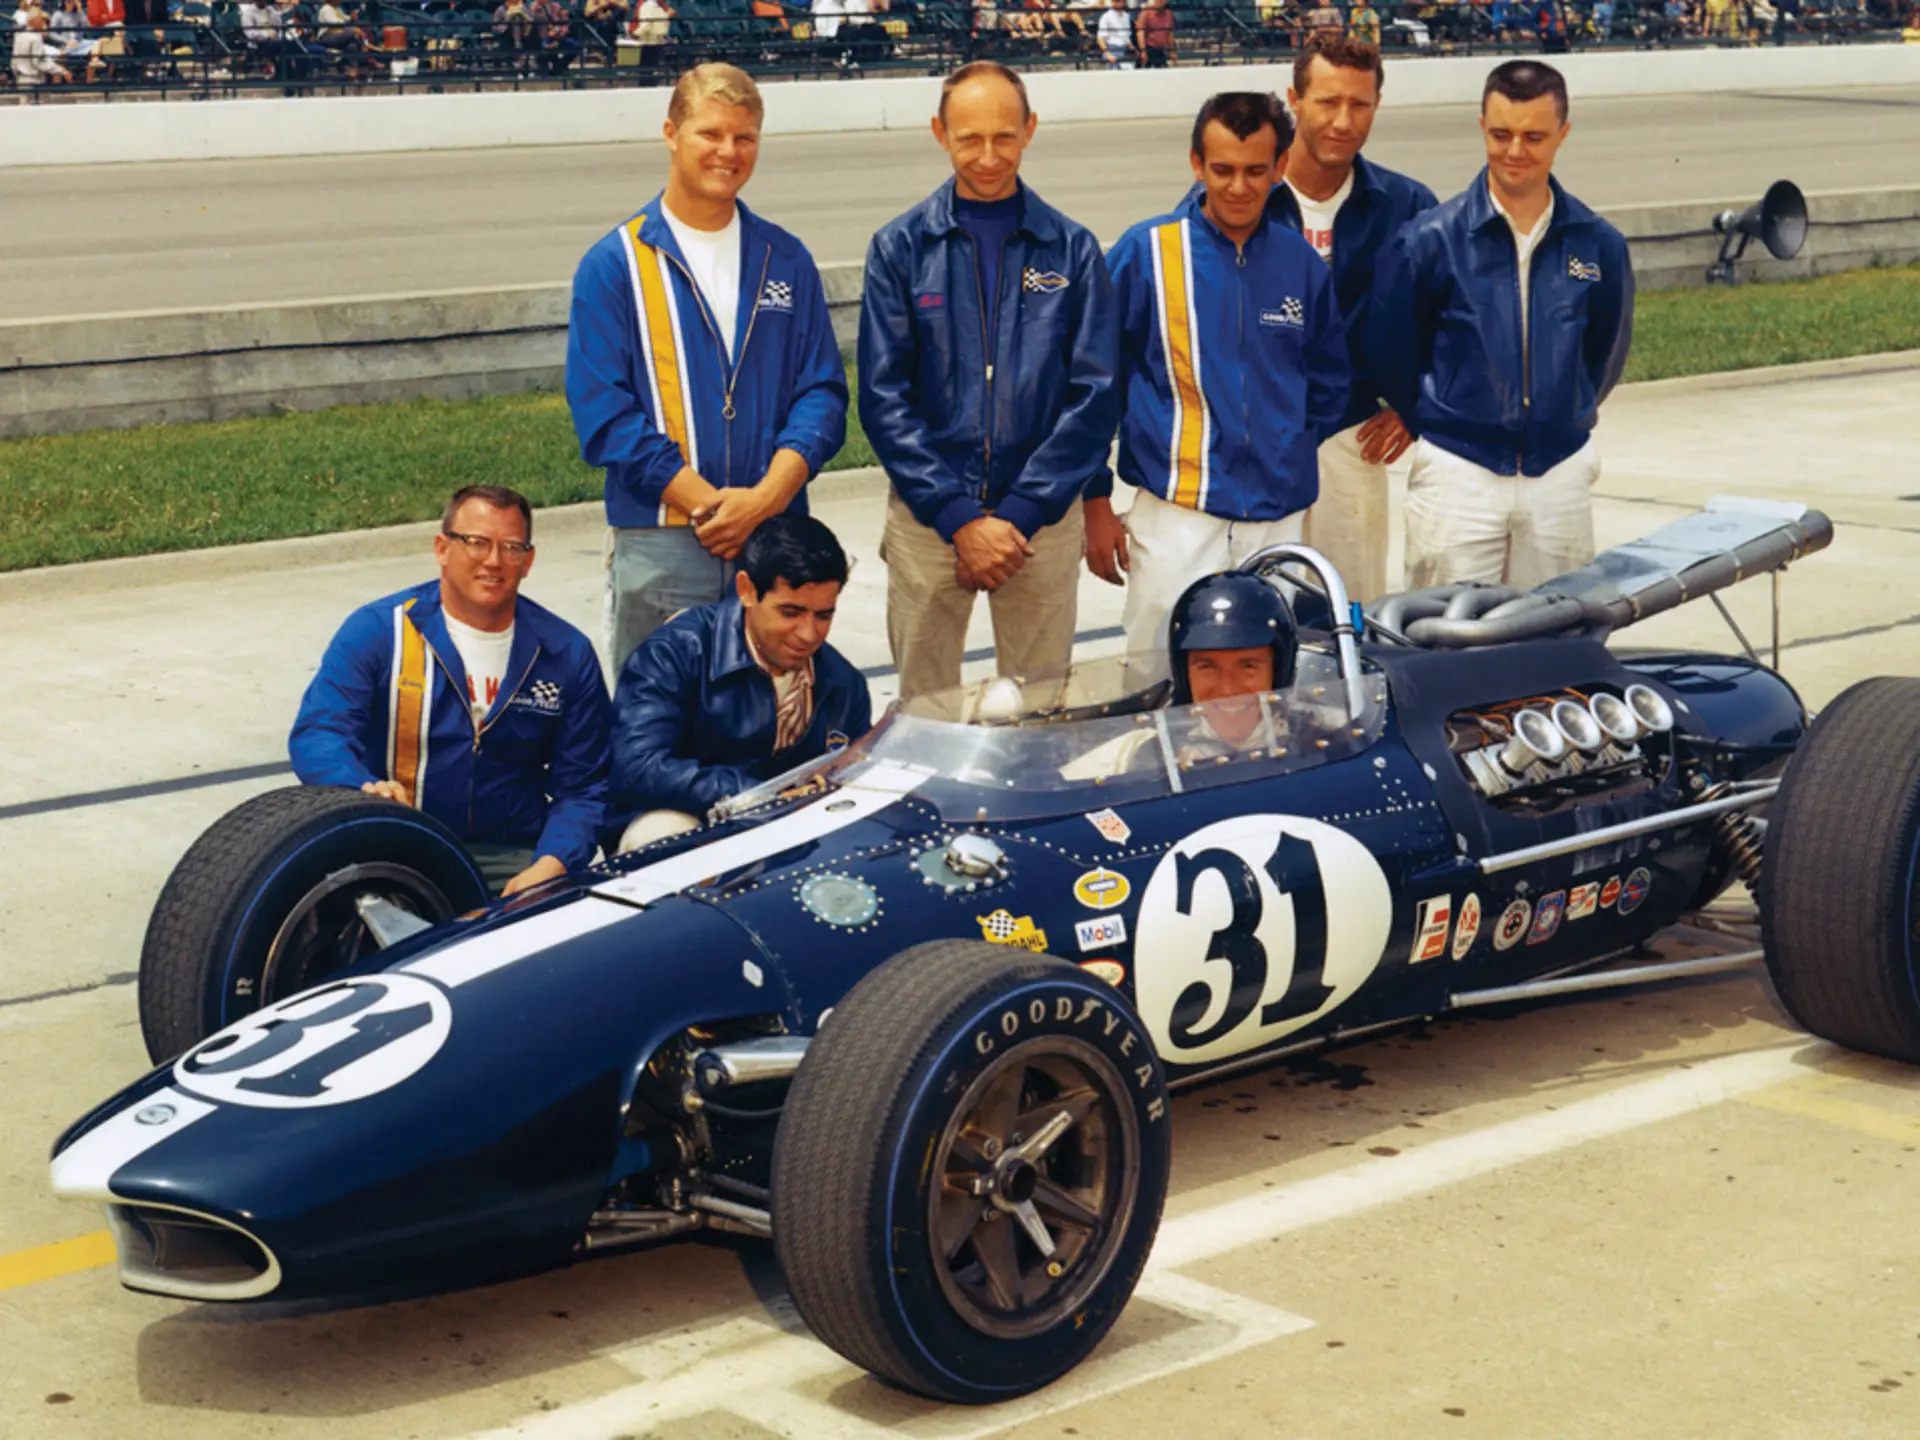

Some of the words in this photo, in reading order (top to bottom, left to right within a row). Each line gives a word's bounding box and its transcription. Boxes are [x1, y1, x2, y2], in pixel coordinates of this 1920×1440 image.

[1081, 920, 1121, 942] Mobil
[1168, 830, 1337, 1050] 31
[181, 981, 434, 1097] 31
